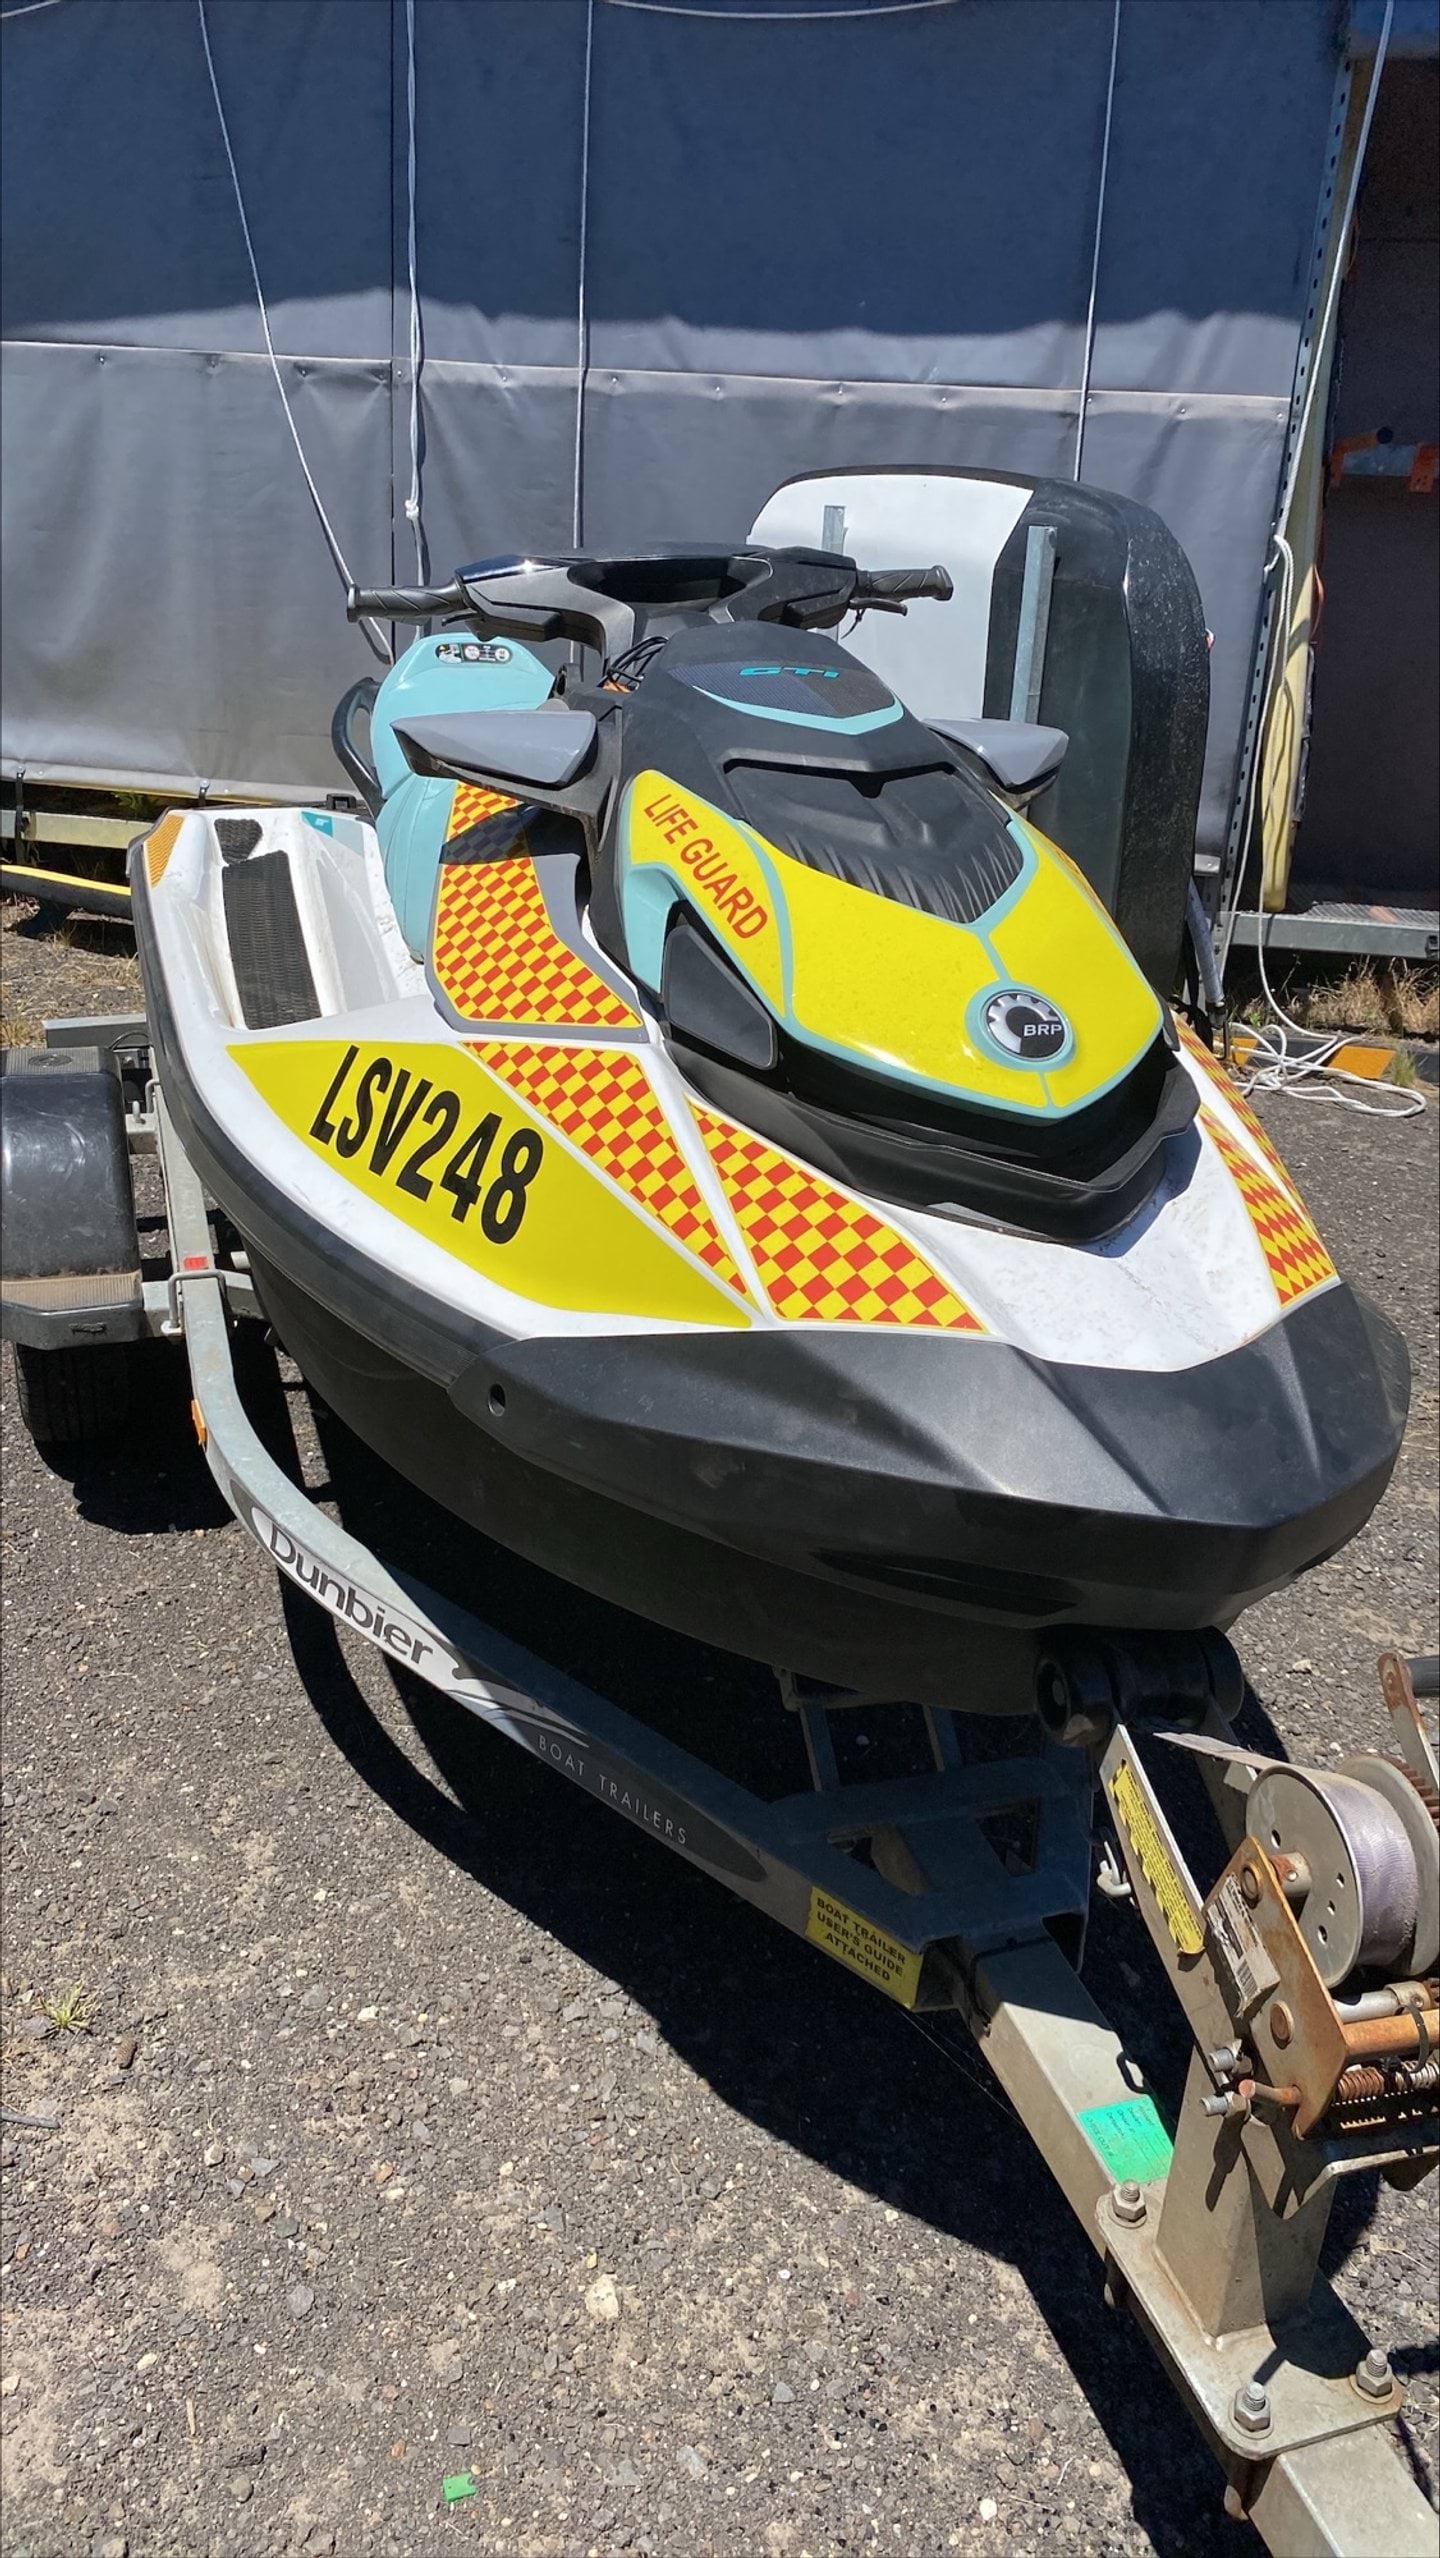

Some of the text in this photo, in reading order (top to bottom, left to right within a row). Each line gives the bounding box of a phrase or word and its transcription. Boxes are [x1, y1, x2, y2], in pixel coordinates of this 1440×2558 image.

[739, 666, 840, 679] GTI
[644, 794, 768, 939] LIFE GUARD
[1023, 1023, 1062, 1037] BRP
[309, 1044, 543, 1244] LSV248
[269, 1523, 433, 1664] Dunbier
[538, 1734, 687, 1845] BOAT TRAILERS
[817, 1898, 905, 1965] BOAT TRAILER
[817, 1911, 903, 1976] USER'S GUIDE
[826, 1932, 890, 1982] ATTACHED
